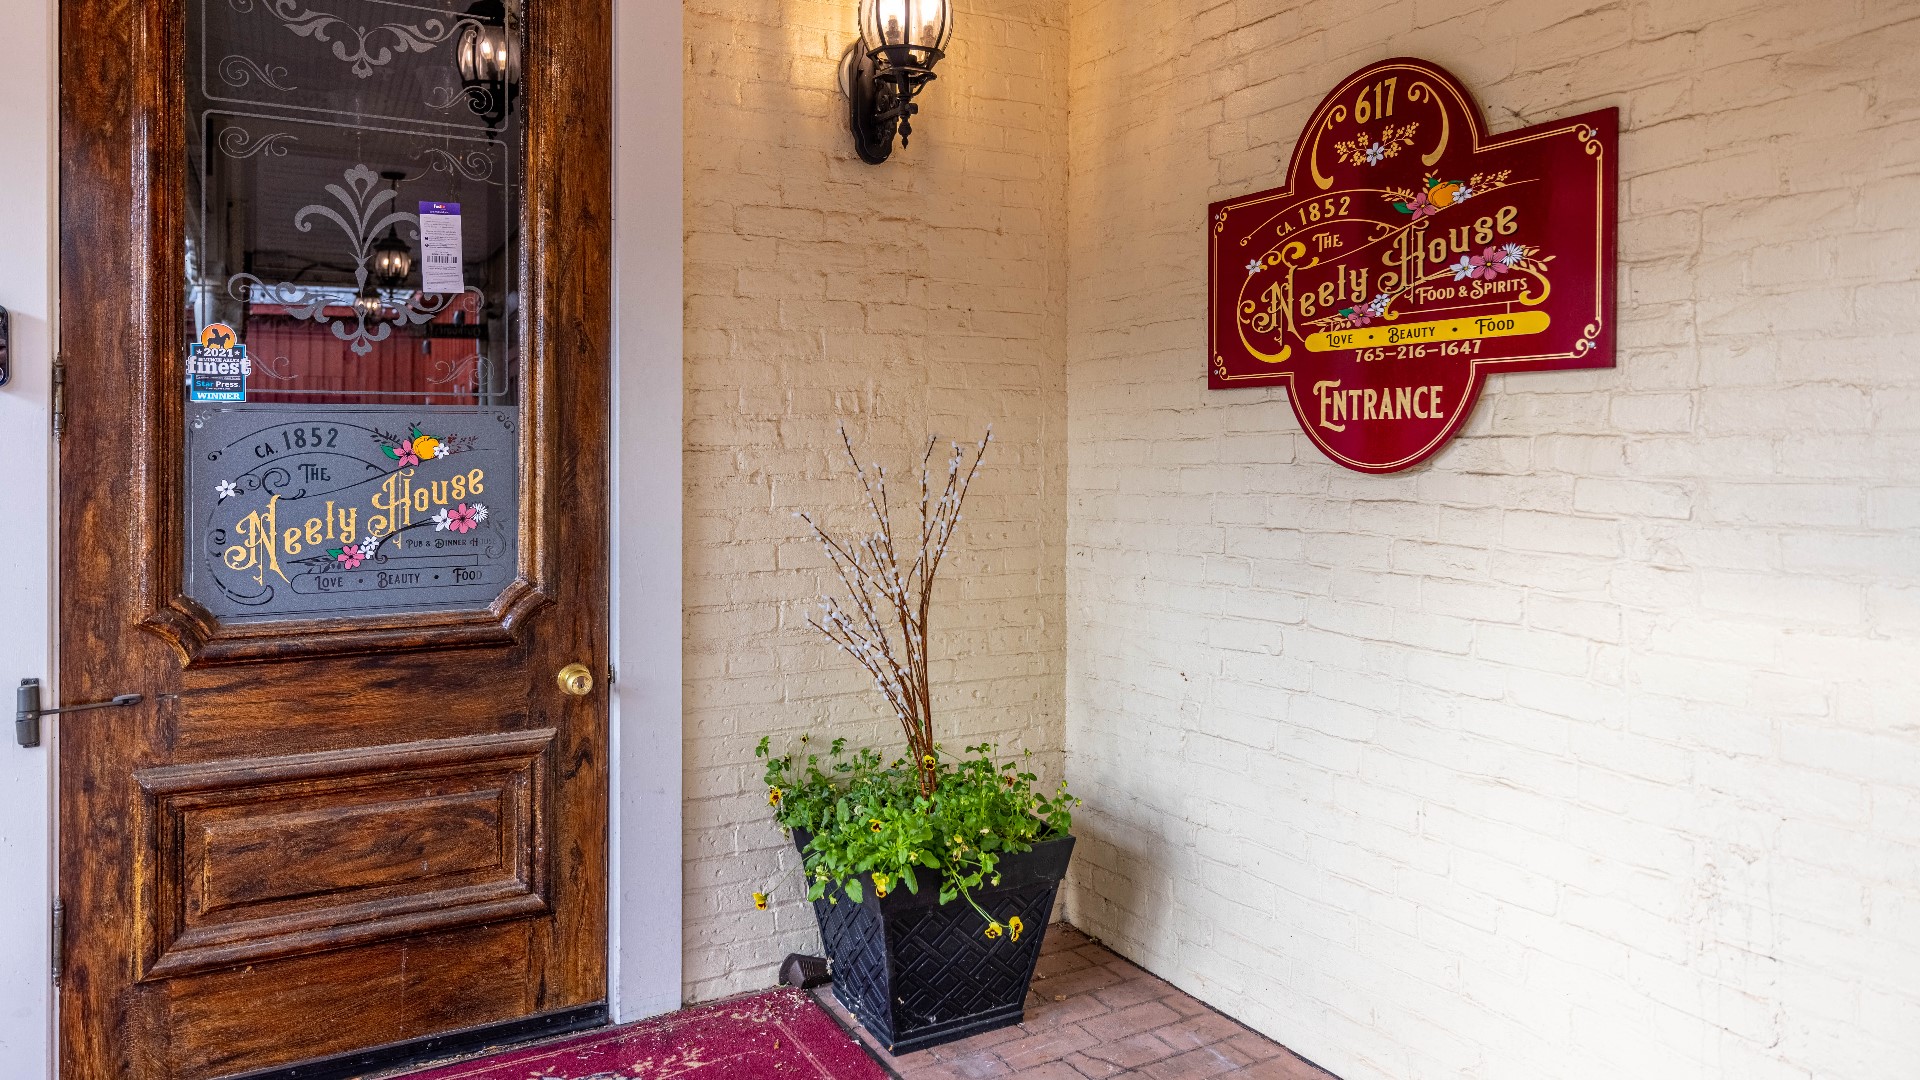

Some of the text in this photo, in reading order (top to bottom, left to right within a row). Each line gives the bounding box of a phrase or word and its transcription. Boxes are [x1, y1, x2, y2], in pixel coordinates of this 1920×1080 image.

[1354, 77, 1397, 123] 617
[1277, 197, 1351, 236] CA. 1852
[1313, 232, 1343, 252] THE
[1252, 205, 1518, 346] Neely House
[1415, 278, 1528, 305] FOOD & SPIRITS
[1326, 317, 1515, 348] LOVE BEAUTY FOOD
[203, 347, 234, 357] 2021
[1355, 340, 1482, 363] 765-216-1647
[187, 355, 251, 375] finest
[196, 392, 241, 400] WINNER
[1313, 380, 1443, 432] ENTRANCE
[254, 427, 339, 459] CA. 1852
[298, 463, 331, 483] THE
[224, 468, 484, 586] Neely House
[406, 539, 423, 550] PUB
[434, 538, 466, 549] DINNER
[315, 567, 482, 592] LOVE BEAUTY FOOD
